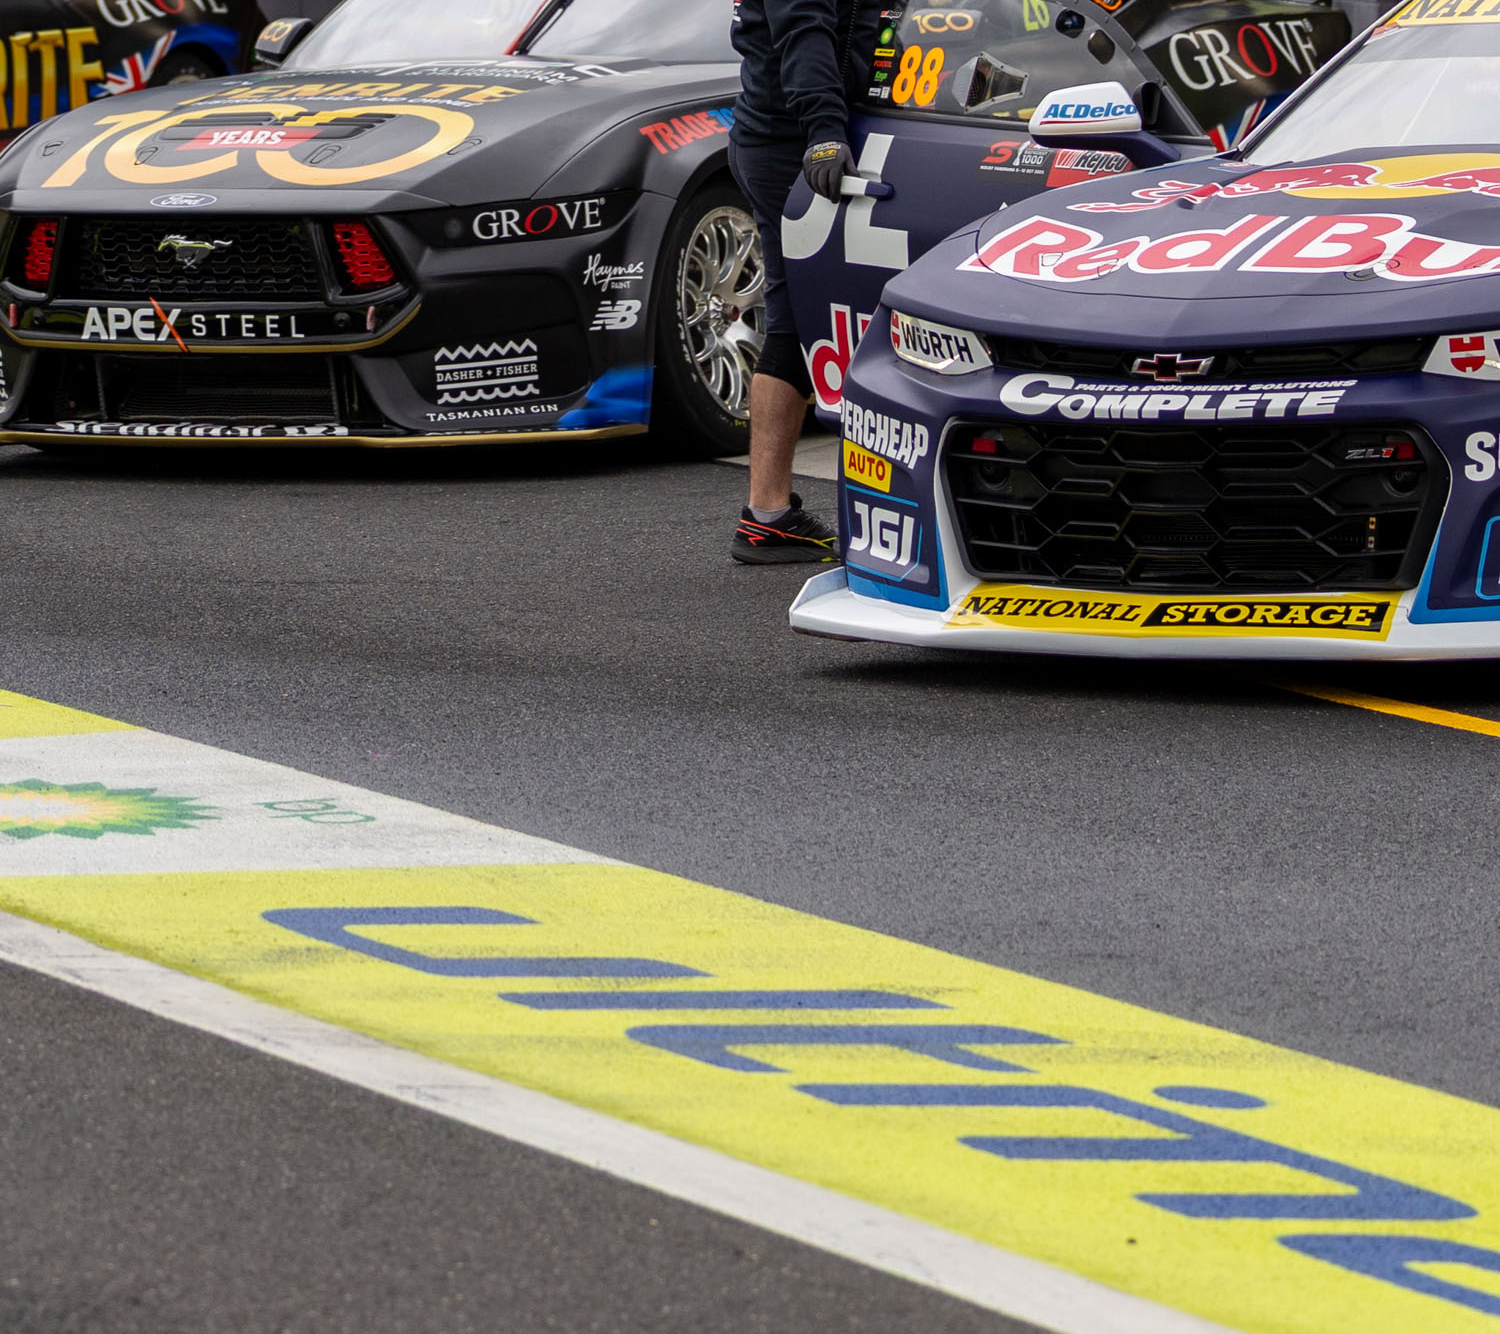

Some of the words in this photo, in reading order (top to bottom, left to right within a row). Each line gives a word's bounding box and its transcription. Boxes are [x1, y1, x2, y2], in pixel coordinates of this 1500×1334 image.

[1168, 20, 1317, 90] GROVE
[892, 45, 945, 106] 88
[1044, 101, 1138, 120] ACDelco
[209, 130, 288, 147] YEARS
[1074, 150, 1130, 176] Repco
[160, 193, 207, 207] Ford
[472, 198, 602, 240] GROVE
[957, 212, 1287, 283] Red
[583, 254, 645, 292] Haymes
[610, 280, 631, 290] PAINT
[81, 304, 186, 343] APEX
[191, 314, 306, 338] STEEL
[900, 320, 975, 363] WÜRTH
[436, 368, 484, 382] DASHER
[496, 364, 538, 379] FISHER
[1074, 382, 1127, 392] PARTS
[1146, 381, 1242, 392] EQUIPMENT
[1247, 379, 1358, 391] SOLUTIONS
[425, 406, 527, 422] TASMANIAN
[529, 403, 559, 416] GIN
[1000, 372, 1345, 420] COMPLETE
[848, 449, 886, 482] AUTO
[1346, 445, 1395, 460] ZL1
[849, 500, 915, 567] JGI
[957, 596, 1144, 623] NATIONAL
[1162, 602, 1377, 630] STORAGE
